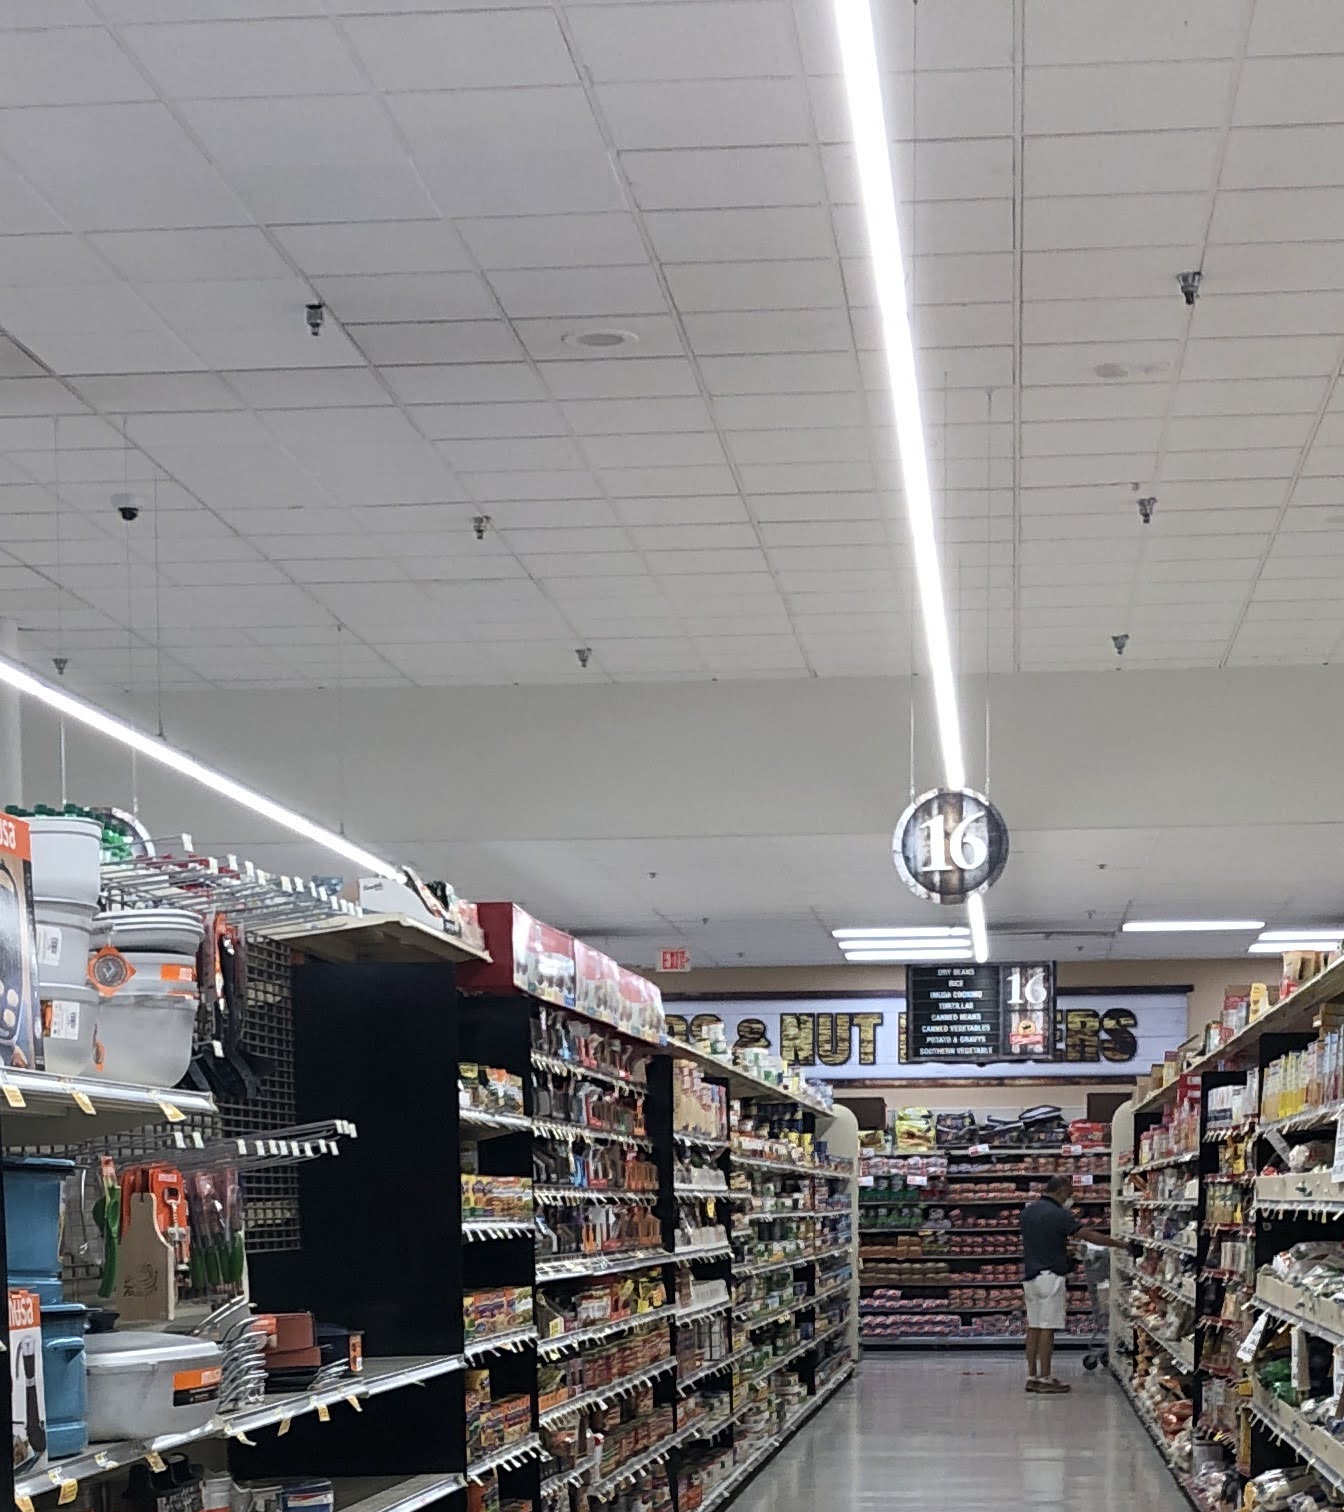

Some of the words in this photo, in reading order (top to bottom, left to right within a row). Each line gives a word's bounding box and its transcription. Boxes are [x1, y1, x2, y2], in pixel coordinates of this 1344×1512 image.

[920, 811, 988, 872] 16
[662, 950, 685, 970] EXIT
[1007, 972, 1047, 1004] 16
[779, 1012, 884, 1066] NUT
[950, 1024, 991, 1032] VEGETABLES
